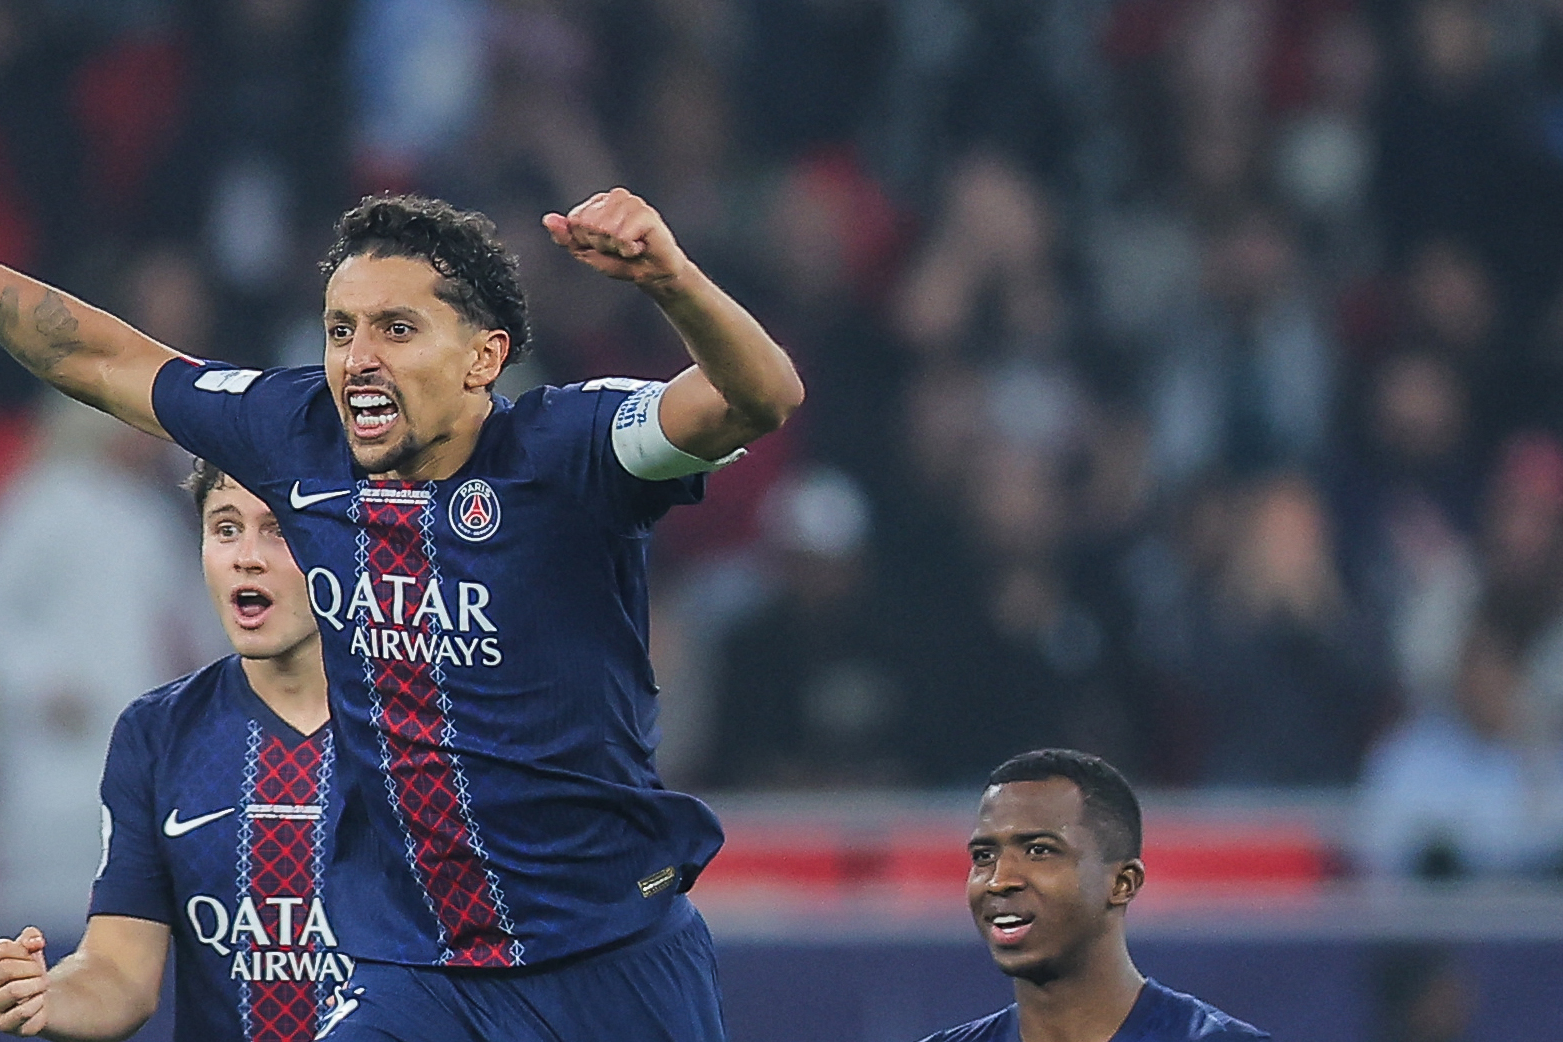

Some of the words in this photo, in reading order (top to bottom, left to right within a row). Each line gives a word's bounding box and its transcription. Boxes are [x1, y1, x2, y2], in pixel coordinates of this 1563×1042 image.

[460, 483, 492, 498] PARIS
[307, 567, 497, 631] QATAR
[350, 626, 502, 666] AIRWAYS
[187, 895, 338, 956] QATA
[230, 951, 355, 982] AIRWAY
